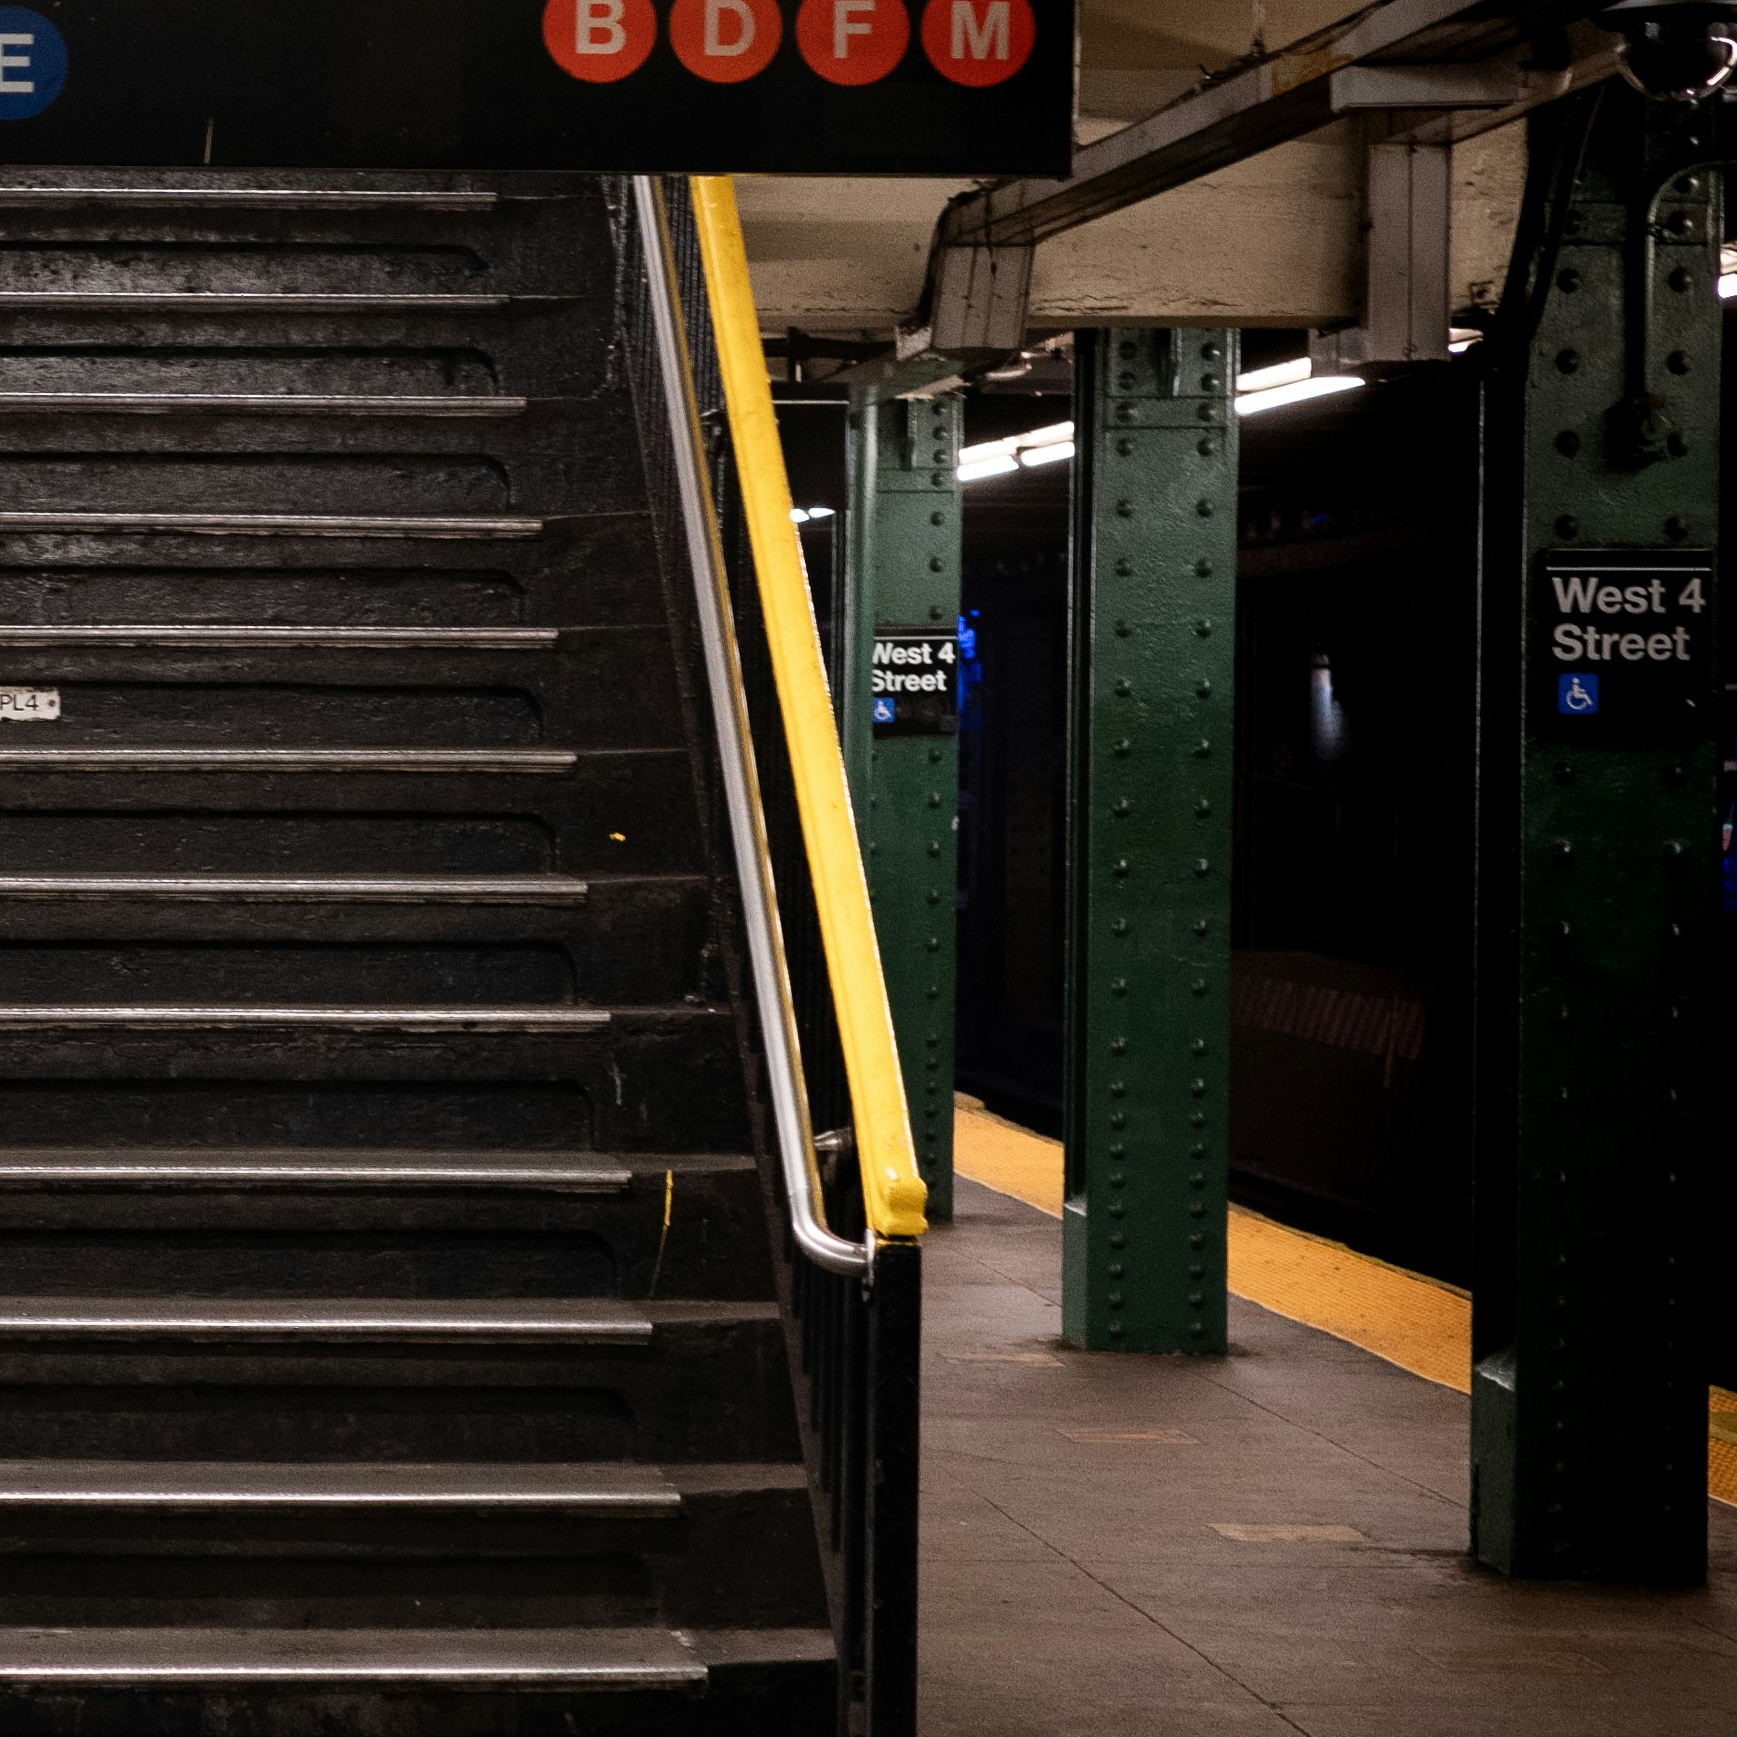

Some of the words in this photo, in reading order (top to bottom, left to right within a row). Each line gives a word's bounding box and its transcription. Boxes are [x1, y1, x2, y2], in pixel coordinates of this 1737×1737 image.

[949, 0, 1011, 61] M
[1551, 576, 1667, 614] West
[1677, 577, 1707, 614] 4
[937, 642, 956, 664] 4
[1551, 622, 1692, 662] Street
[871, 669, 948, 693] Street
[0, 693, 39, 711] PL4
